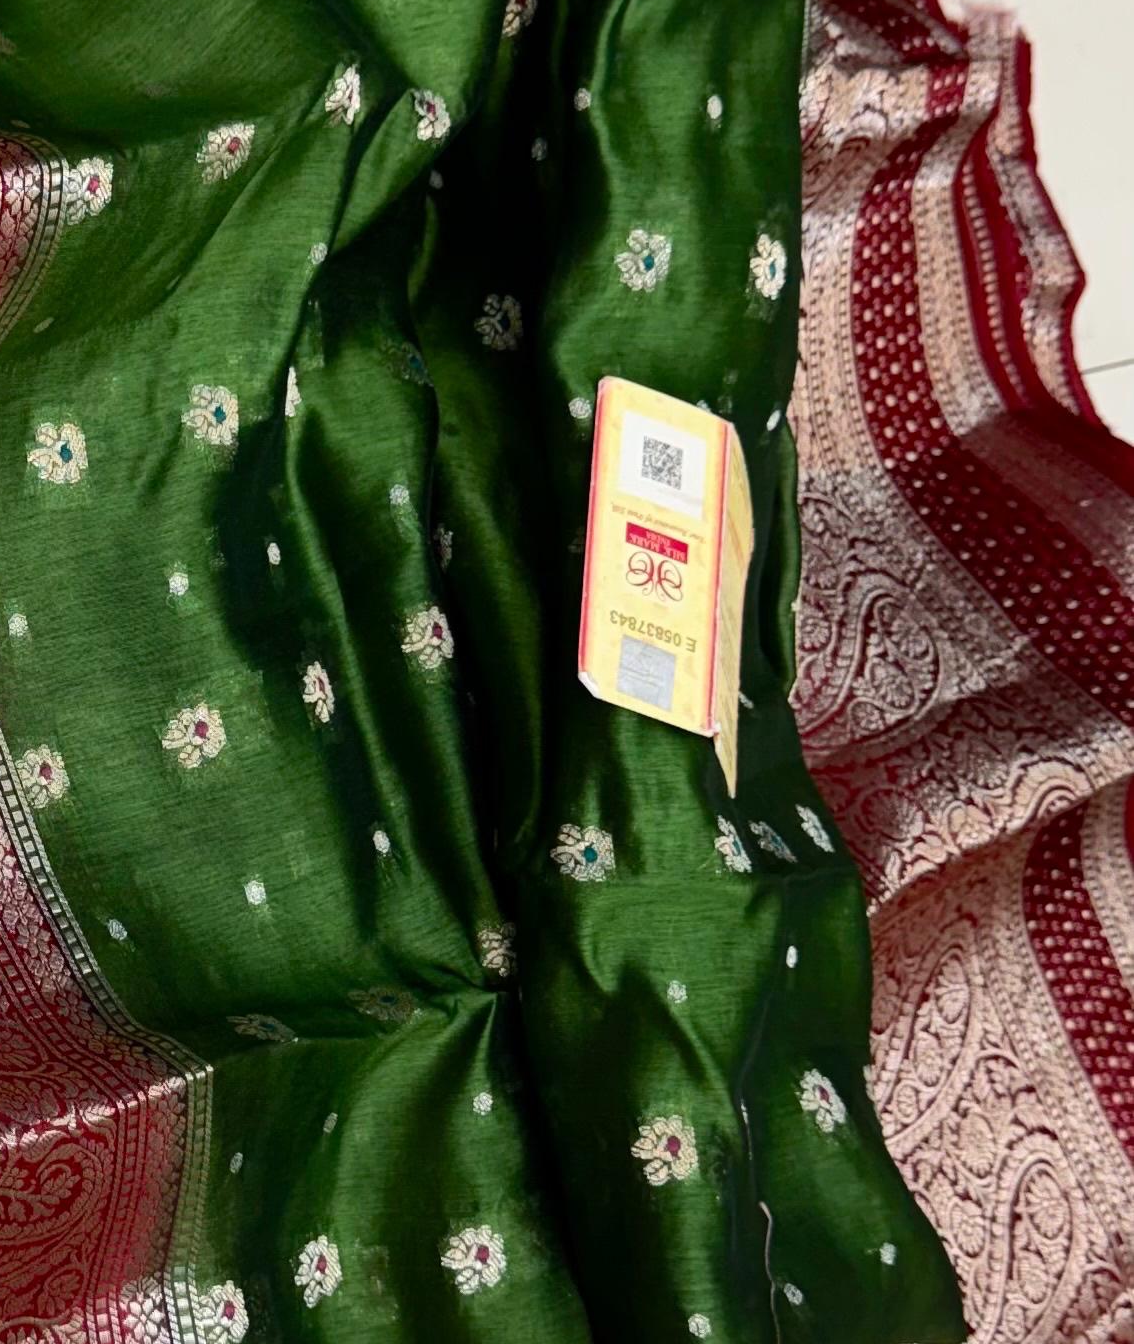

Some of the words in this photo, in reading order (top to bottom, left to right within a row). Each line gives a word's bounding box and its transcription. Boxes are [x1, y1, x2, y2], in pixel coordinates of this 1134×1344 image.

[628, 532, 662, 552] MARK
[663, 546, 687, 562] SILK
[609, 609, 683, 648] 05837843
[686, 636, 698, 654] E
